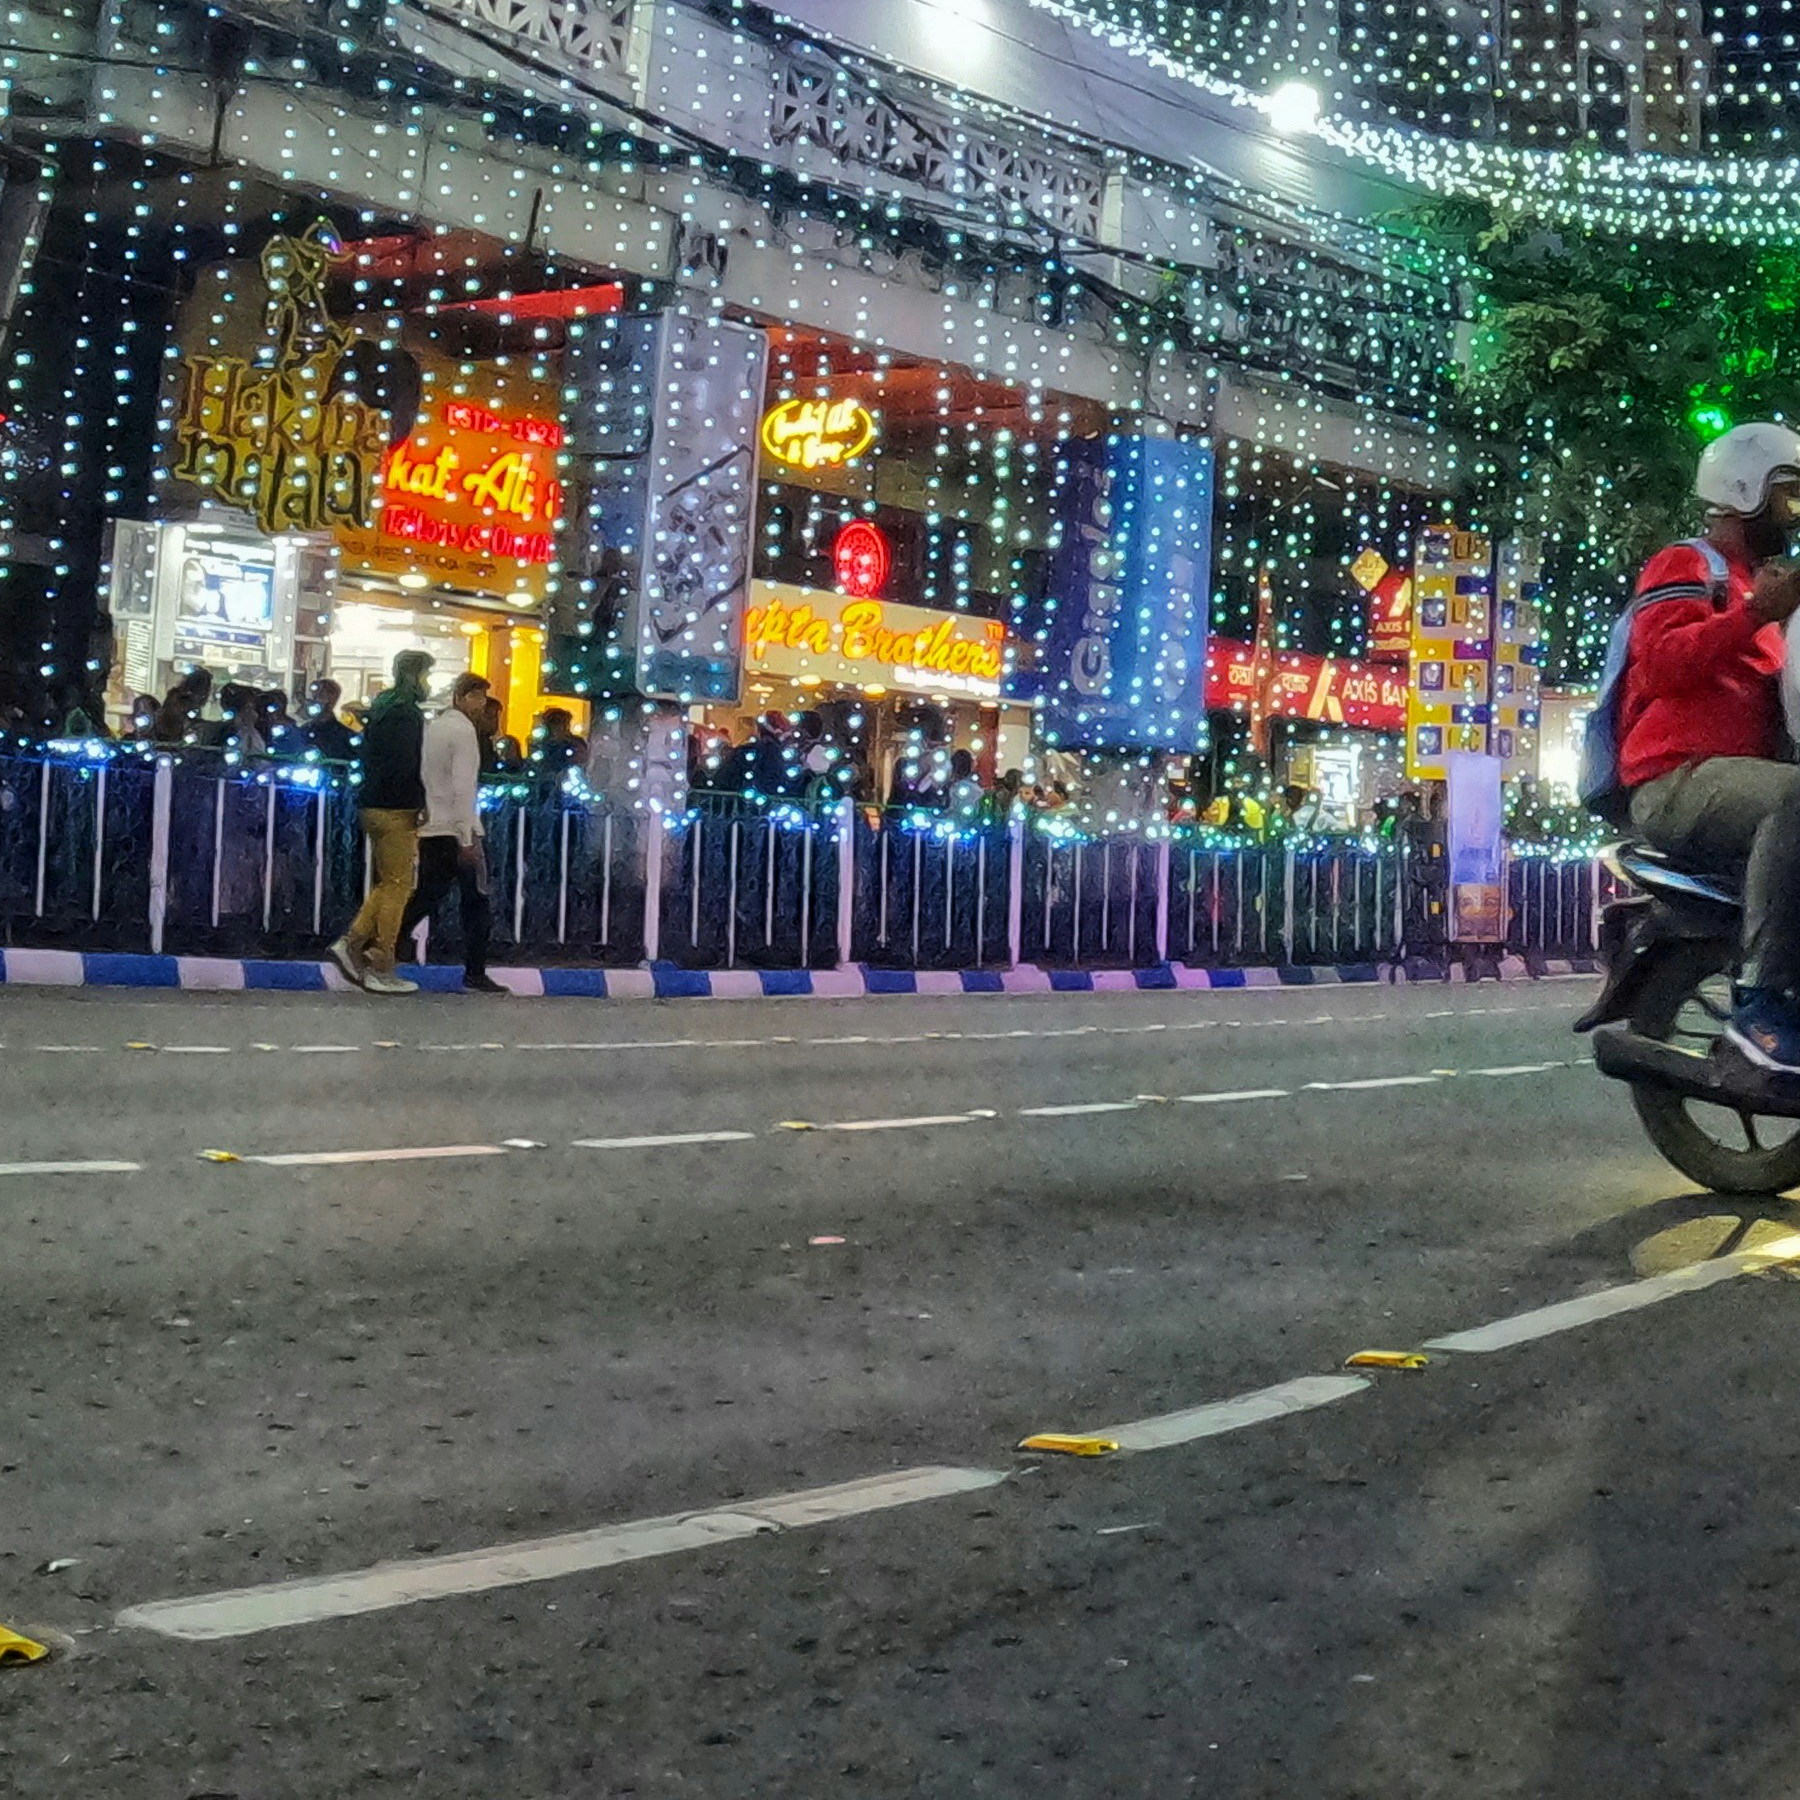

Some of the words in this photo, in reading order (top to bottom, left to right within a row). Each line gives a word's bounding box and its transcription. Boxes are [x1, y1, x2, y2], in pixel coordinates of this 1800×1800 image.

[462, 451, 537, 516] Ali
[385, 504, 459, 546] Tailors
[840, 600, 1002, 678] Brothers
[1342, 677, 1378, 704] AXIS
